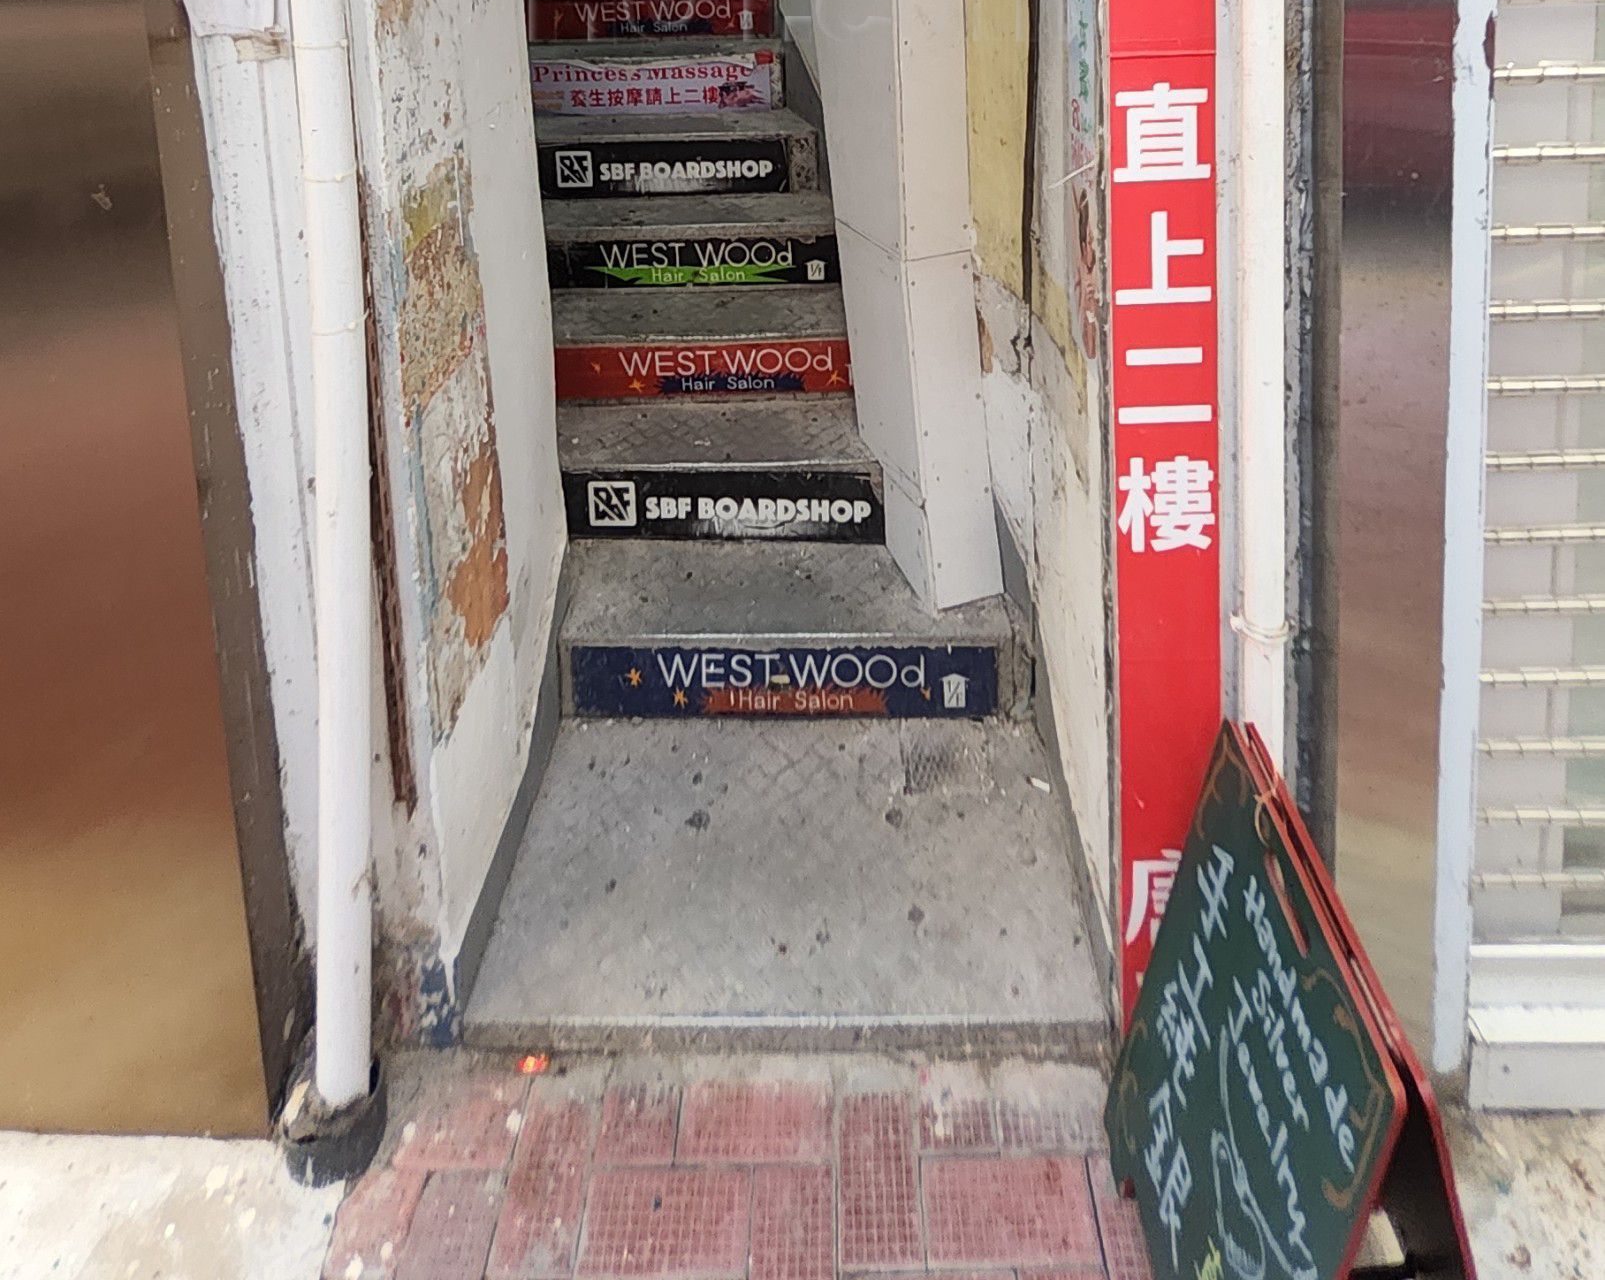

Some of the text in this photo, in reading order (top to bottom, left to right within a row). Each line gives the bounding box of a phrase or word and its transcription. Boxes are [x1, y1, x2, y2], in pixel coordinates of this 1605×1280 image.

[574, 1, 649, 23] WEST
[621, 22, 688, 34] Hair Salon
[533, 63, 751, 83] Princess Massage
[600, 163, 635, 182] SBF
[641, 160, 773, 180] BOARDSHOP
[600, 243, 684, 269] WEST
[652, 269, 746, 283] Hair Salon
[1112, 81, 1216, 554] 直上二樓
[618, 351, 717, 377] WEST
[681, 376, 775, 391] Hair Salon
[645, 496, 692, 520] SBF
[699, 496, 872, 524] BOARDSHOP
[657, 652, 780, 689] WEST
[739, 690, 854, 711] Hair Salon
